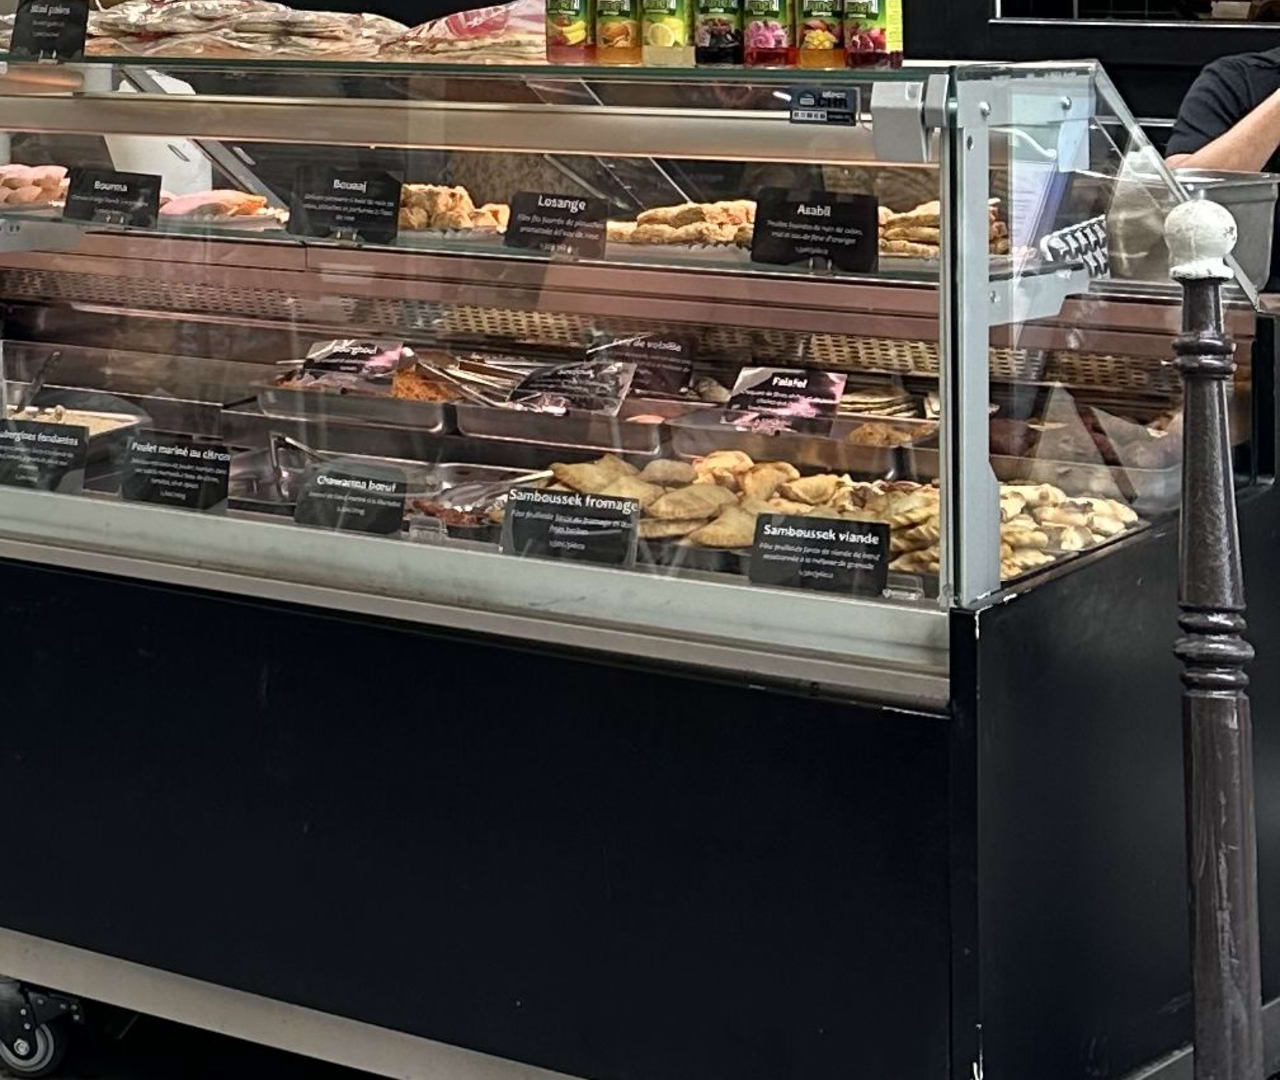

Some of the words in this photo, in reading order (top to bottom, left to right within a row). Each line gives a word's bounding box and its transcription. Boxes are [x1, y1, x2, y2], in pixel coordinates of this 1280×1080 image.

[538, 195, 586, 214] Losange
[772, 376, 808, 389] Falafel
[509, 488, 583, 507] Samboussek
[584, 495, 640, 516] fromage
[763, 524, 836, 541] Samboussek
[838, 531, 880, 545] viande
